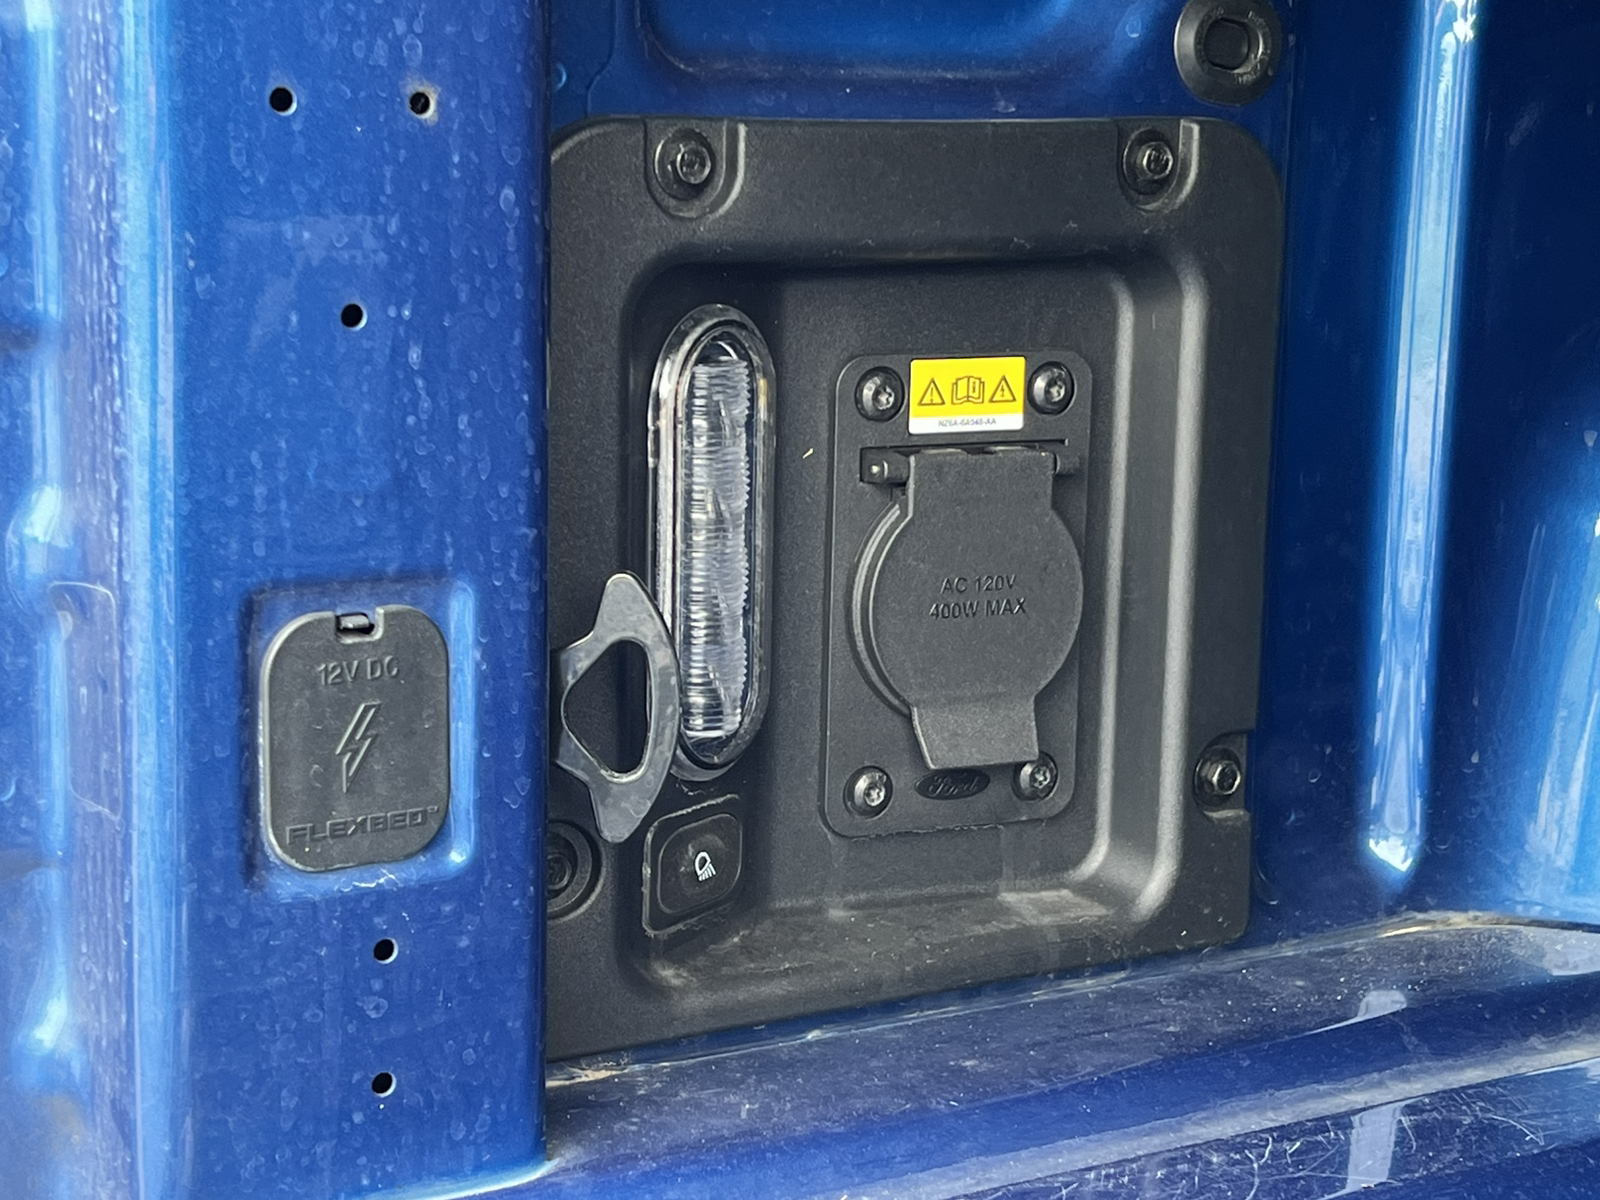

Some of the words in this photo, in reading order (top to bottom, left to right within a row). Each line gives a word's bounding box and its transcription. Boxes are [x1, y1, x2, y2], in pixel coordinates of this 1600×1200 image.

[940, 577, 967, 594] AC
[975, 574, 1016, 592] 120V
[929, 600, 979, 619] 400W
[984, 597, 1026, 616] MAX
[317, 660, 359, 685] 12V
[366, 655, 399, 679] DC
